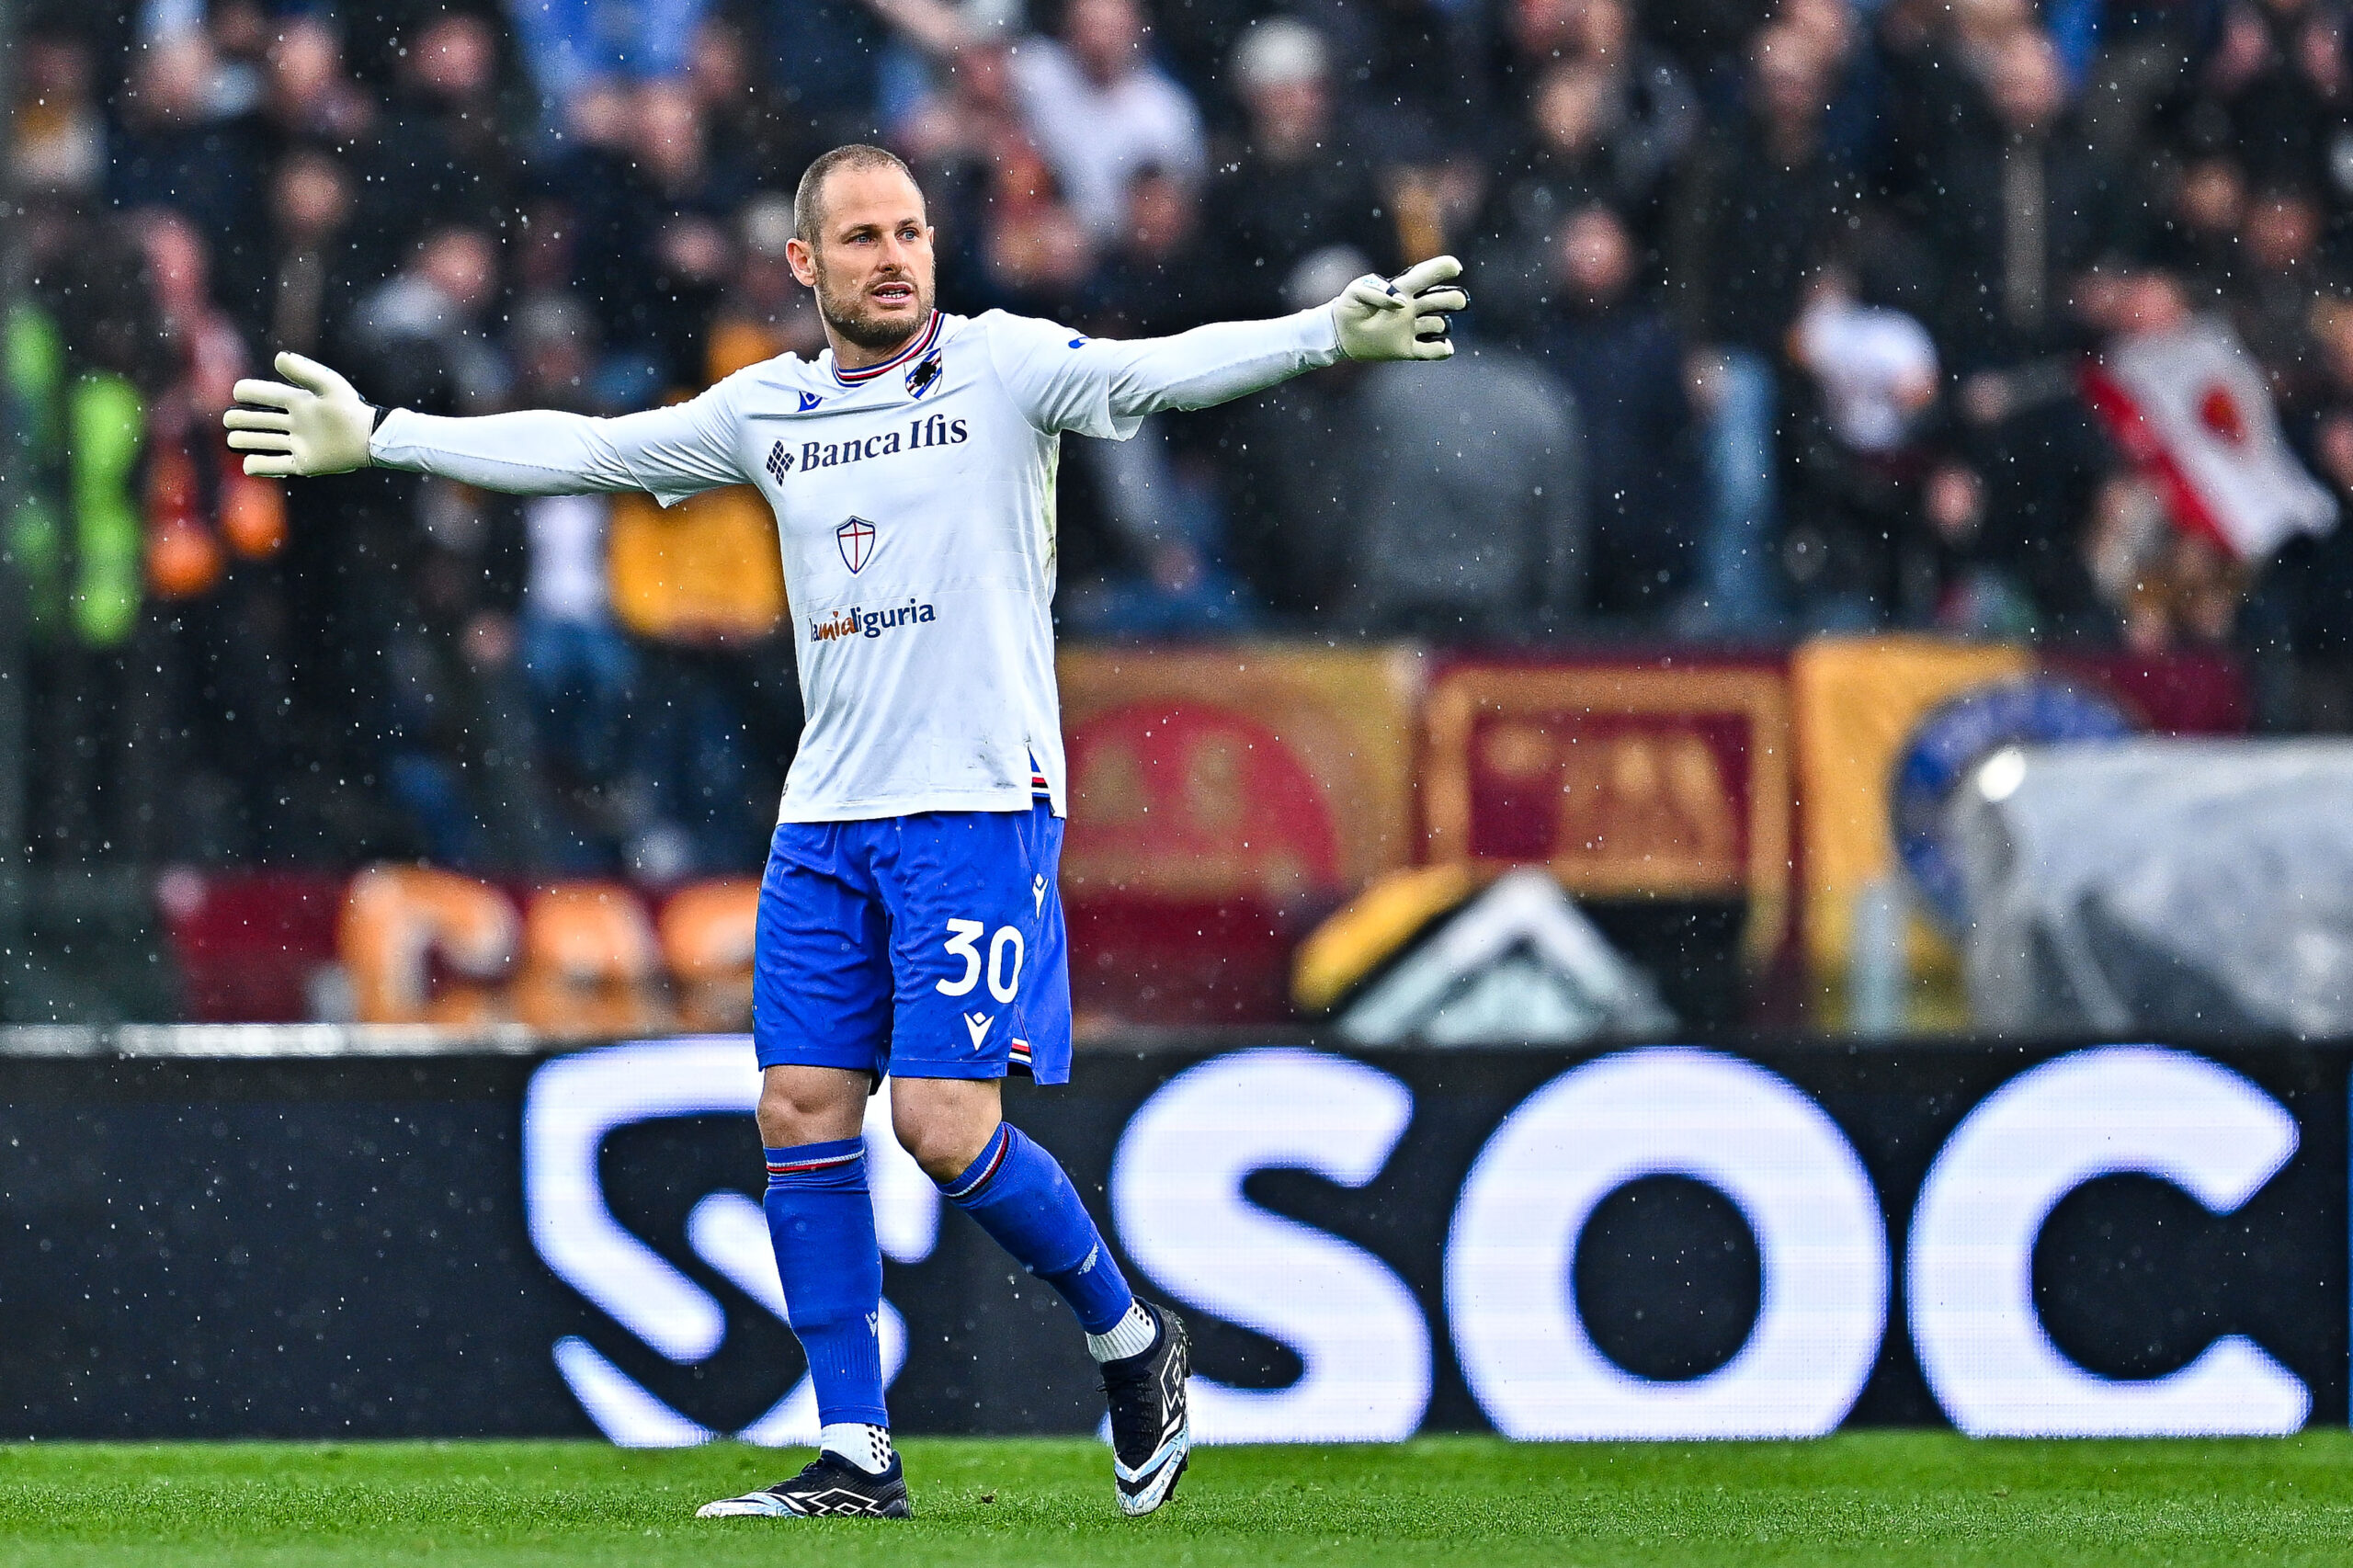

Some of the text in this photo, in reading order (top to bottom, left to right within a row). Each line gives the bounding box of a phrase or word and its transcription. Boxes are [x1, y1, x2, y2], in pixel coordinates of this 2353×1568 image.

[800, 414, 968, 472] Banca Ifis
[936, 917, 1025, 1004] 30
[1103, 1046, 2353, 1443] SOC
